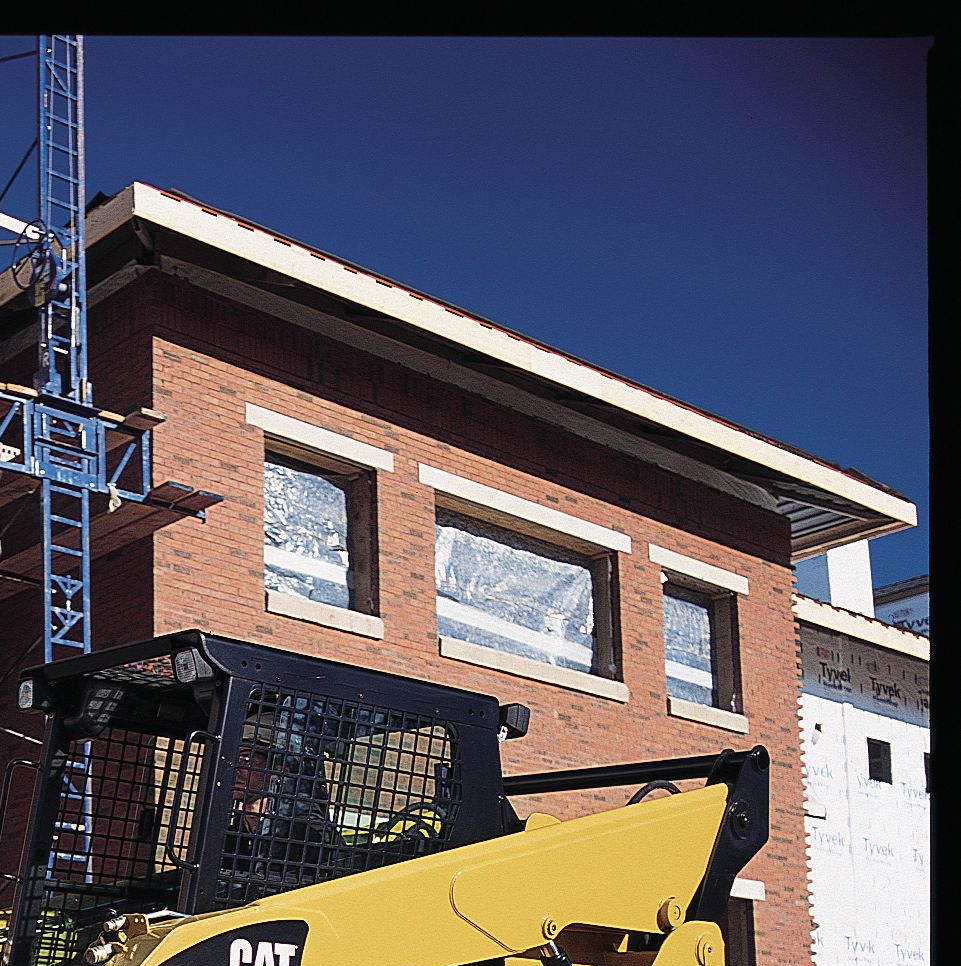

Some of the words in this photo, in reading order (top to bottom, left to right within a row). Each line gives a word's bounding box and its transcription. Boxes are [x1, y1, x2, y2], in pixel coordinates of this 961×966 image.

[869, 676, 901, 699] Tyvek
[805, 764, 833, 780] yvek
[812, 826, 845, 846] Tyvek
[862, 837, 895, 858] Tyvek
[894, 943, 924, 961] Tyvek
